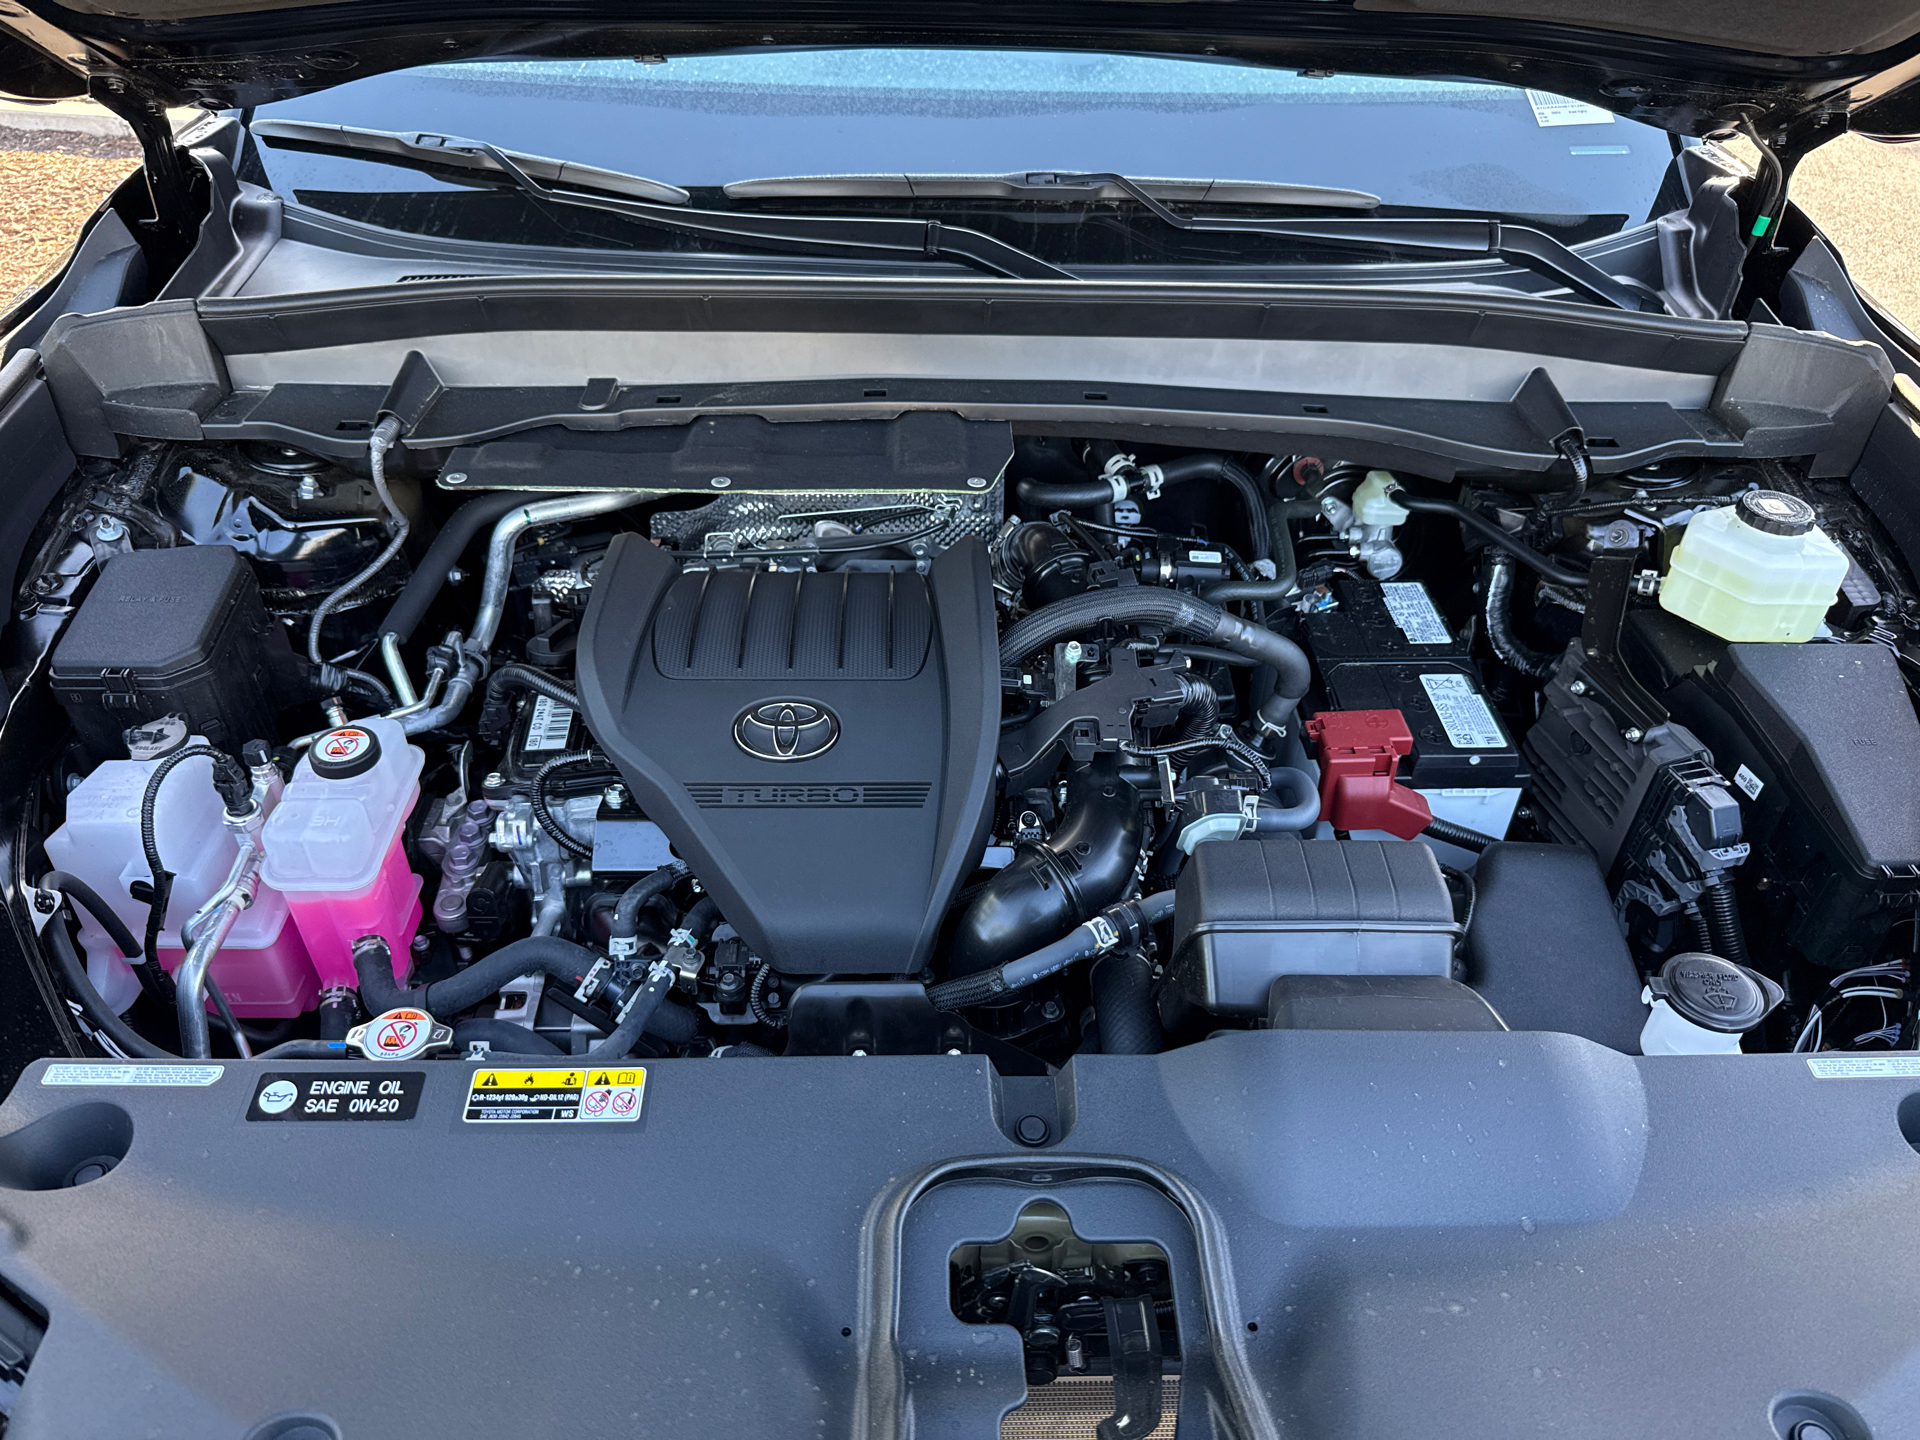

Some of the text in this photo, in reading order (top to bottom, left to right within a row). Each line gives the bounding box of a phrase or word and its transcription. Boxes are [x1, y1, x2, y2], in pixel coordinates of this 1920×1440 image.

[159, 595, 182, 603] FUSE
[1852, 738, 1878, 746] FUSE
[728, 786, 861, 804] TURBO
[309, 1080, 404, 1095] ENGINE OIL
[303, 1098, 400, 1113] SAE 0W-20
[560, 1109, 575, 1118] WS
